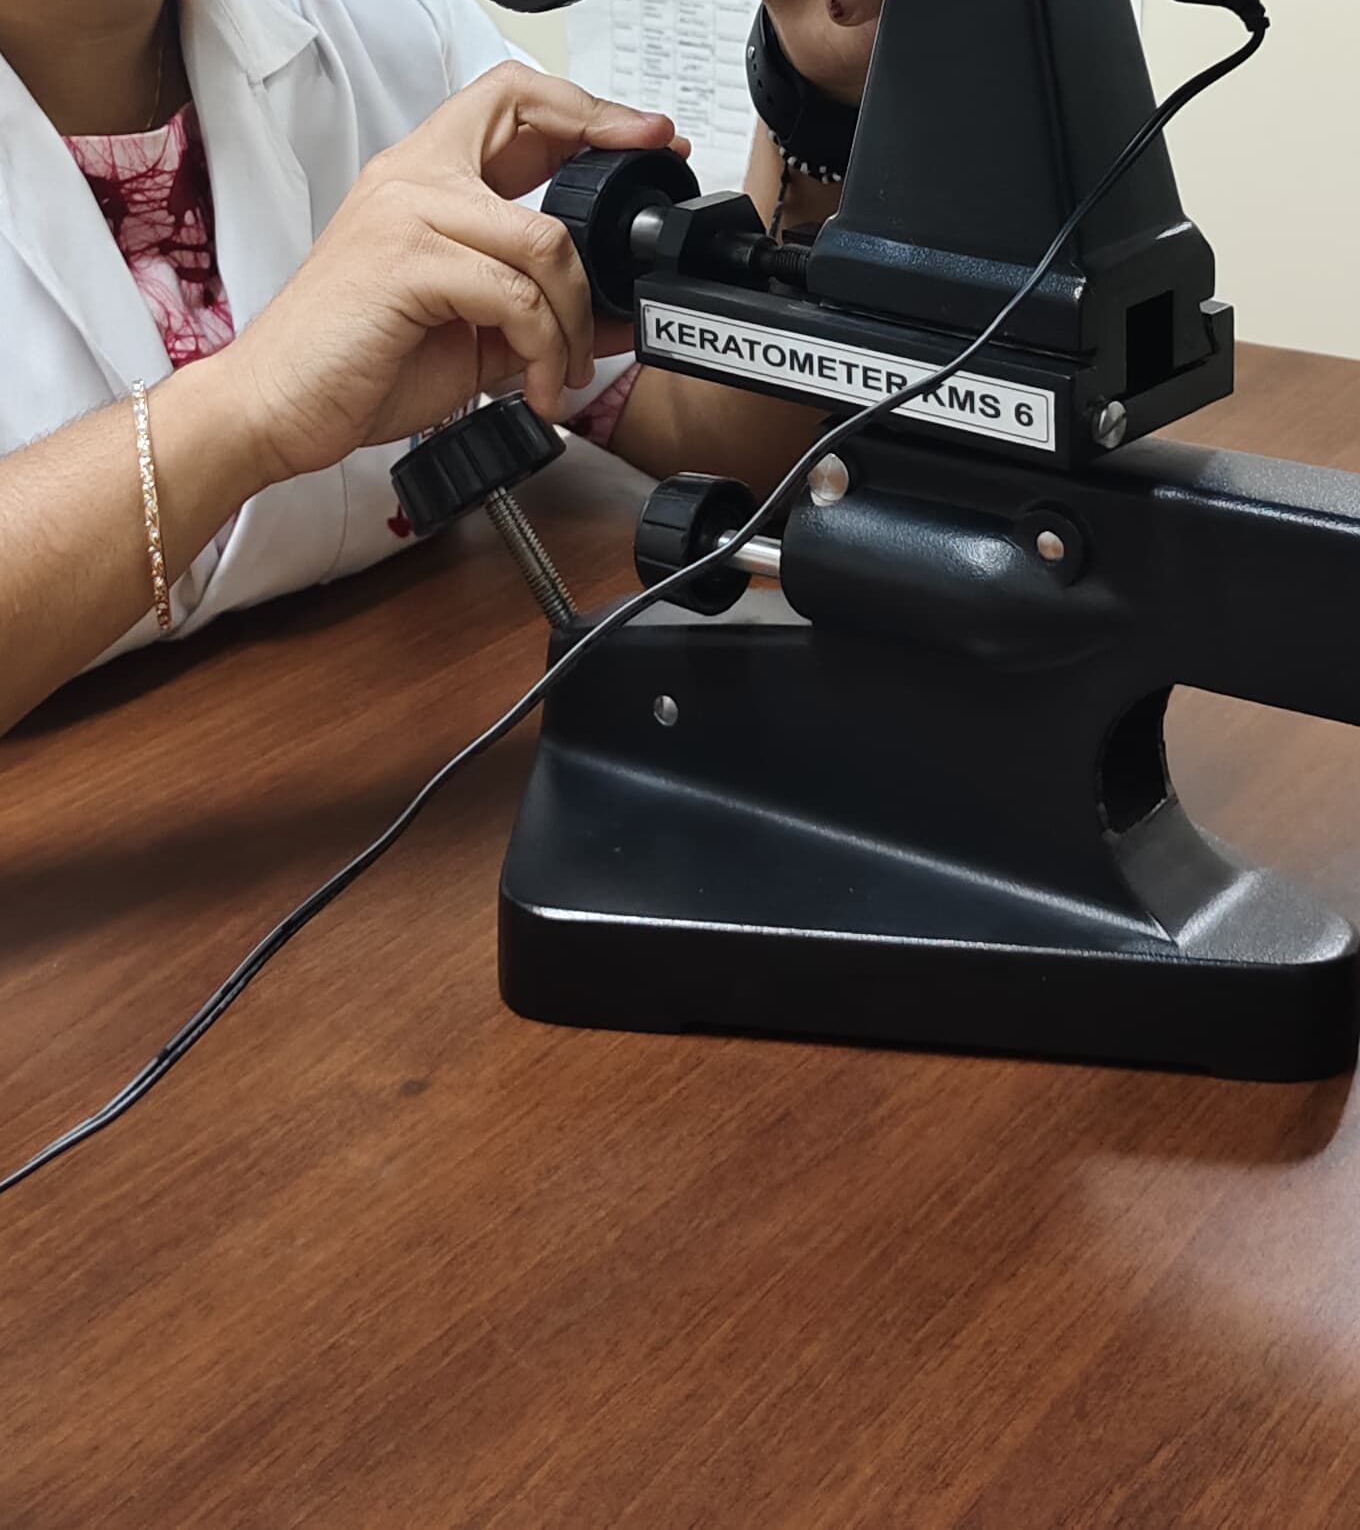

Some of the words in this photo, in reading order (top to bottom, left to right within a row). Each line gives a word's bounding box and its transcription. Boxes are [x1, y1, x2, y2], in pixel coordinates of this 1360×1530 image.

[655, 318, 908, 395] KERATOMETER
[921, 380, 1001, 419] KMS
[1014, 403, 1034, 427] 6
